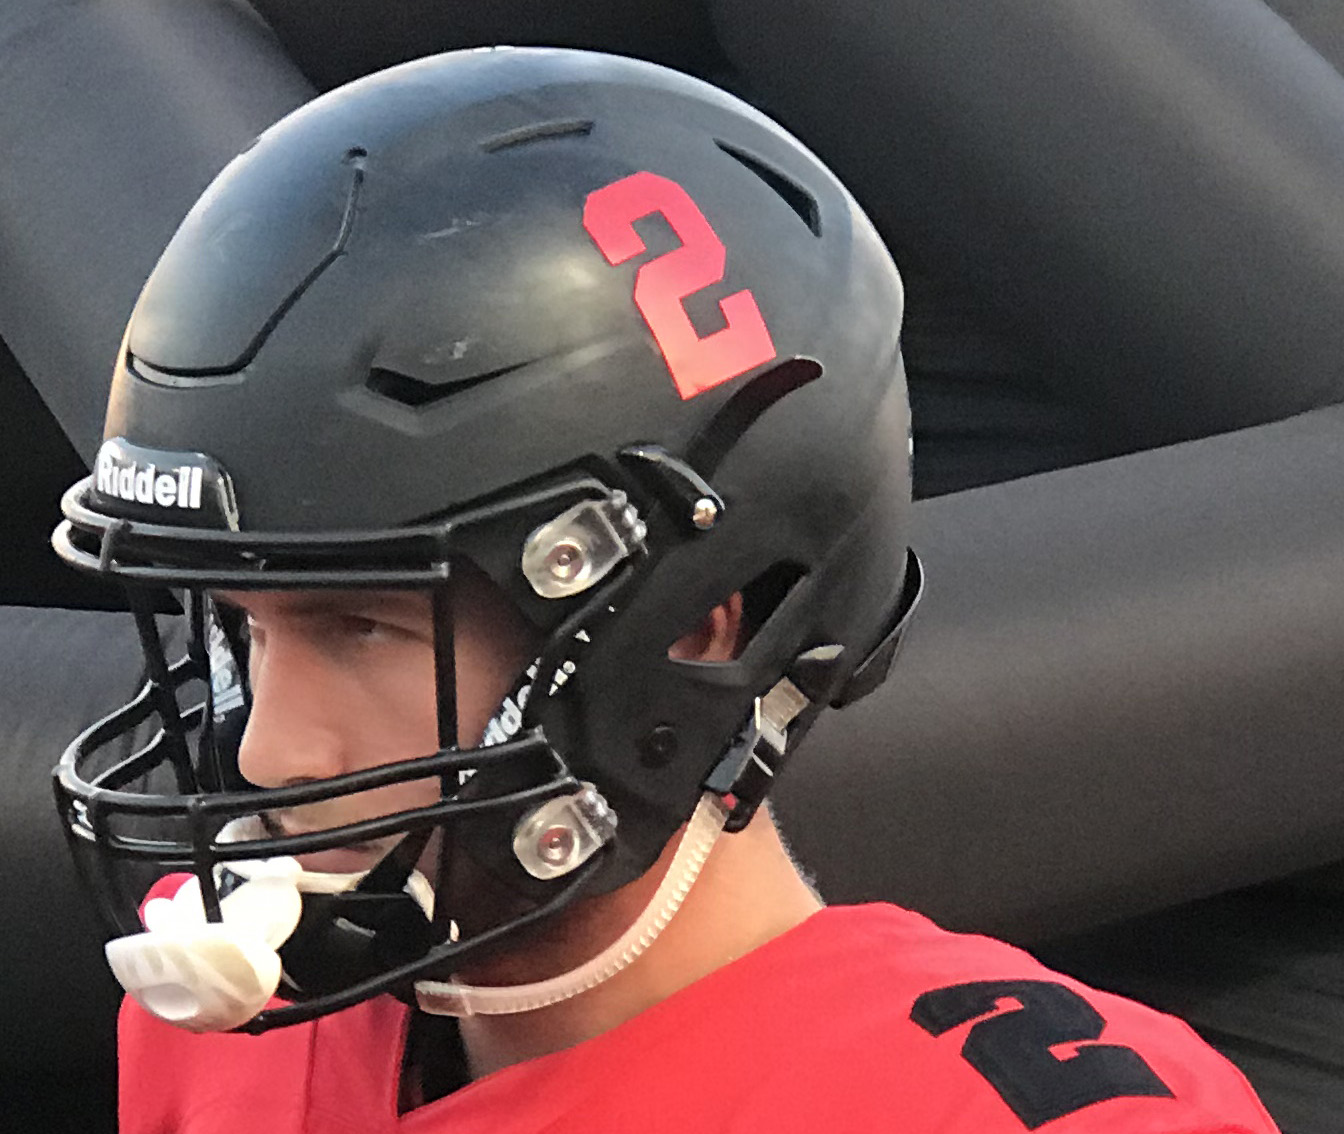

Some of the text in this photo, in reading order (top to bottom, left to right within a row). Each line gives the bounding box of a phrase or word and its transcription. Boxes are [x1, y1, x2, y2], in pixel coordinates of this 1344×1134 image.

[582, 170, 777, 401] 2
[97, 448, 204, 509] Riddell
[908, 978, 1177, 1132] 2
